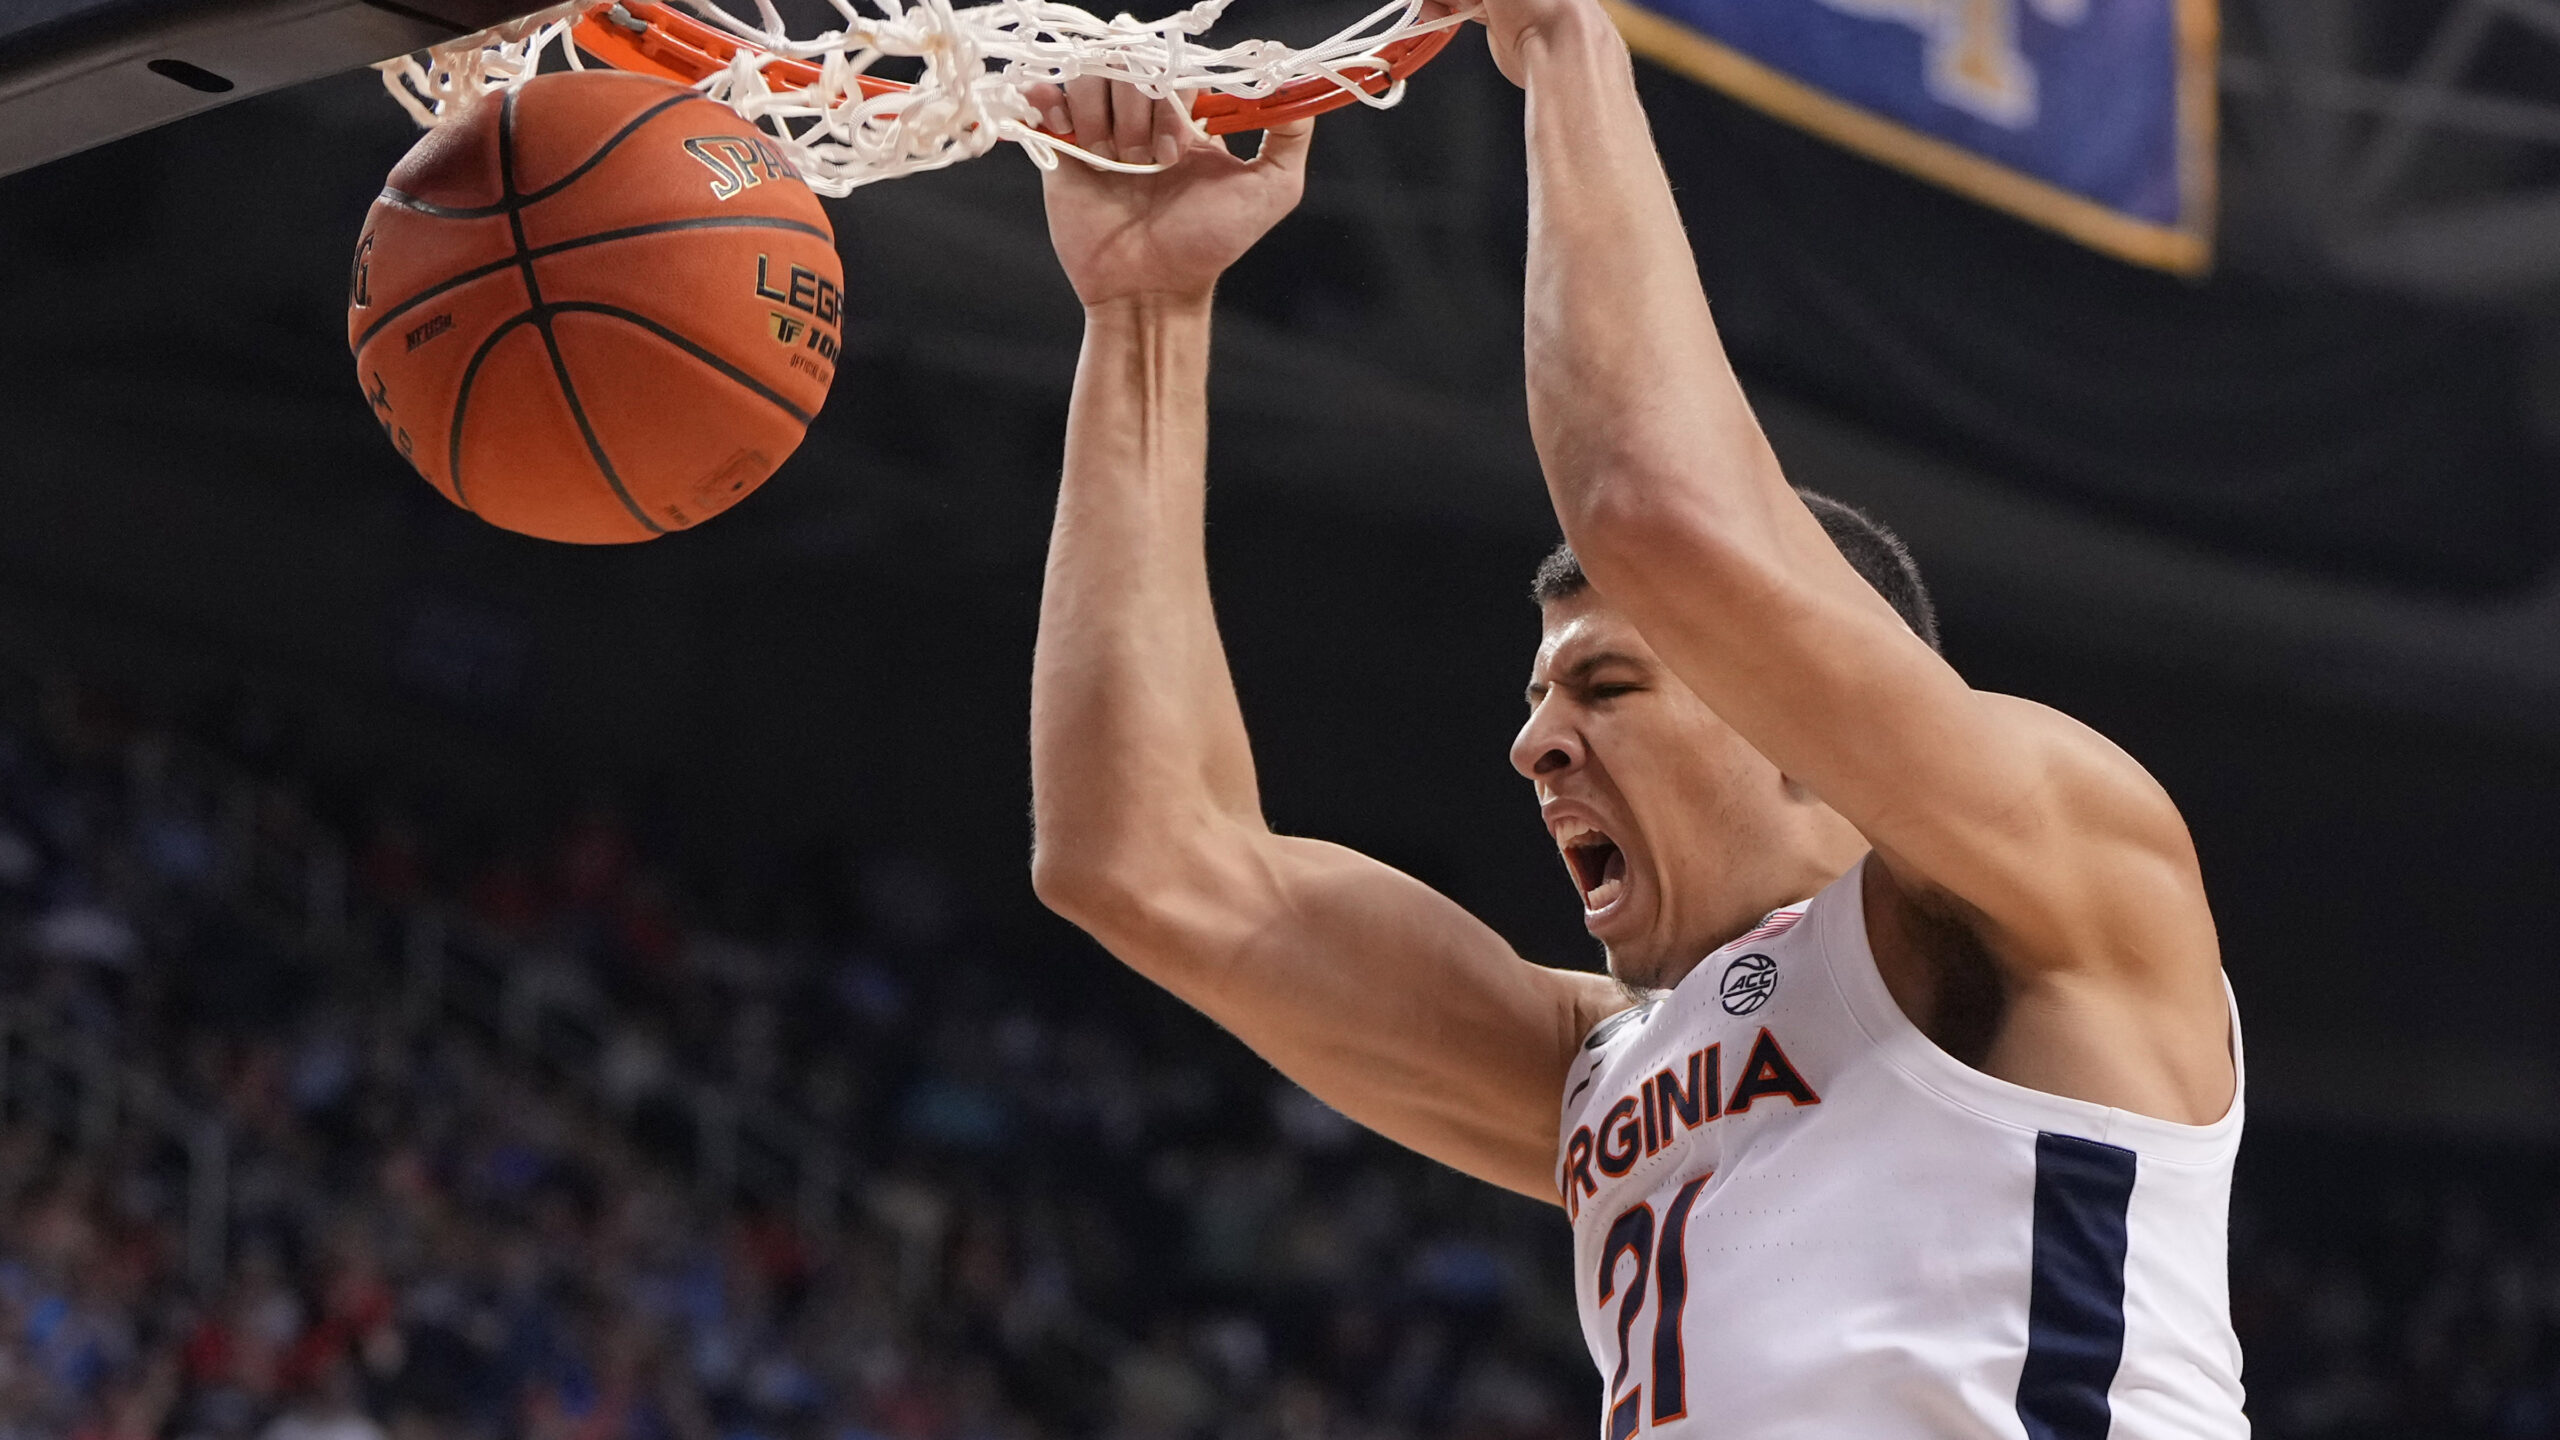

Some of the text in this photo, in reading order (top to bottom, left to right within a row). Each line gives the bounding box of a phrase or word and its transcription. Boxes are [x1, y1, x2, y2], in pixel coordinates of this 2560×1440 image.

[769, 311, 805, 343] TF
[1727, 968, 1777, 993] ACC
[1598, 1171, 1713, 1440] 21
